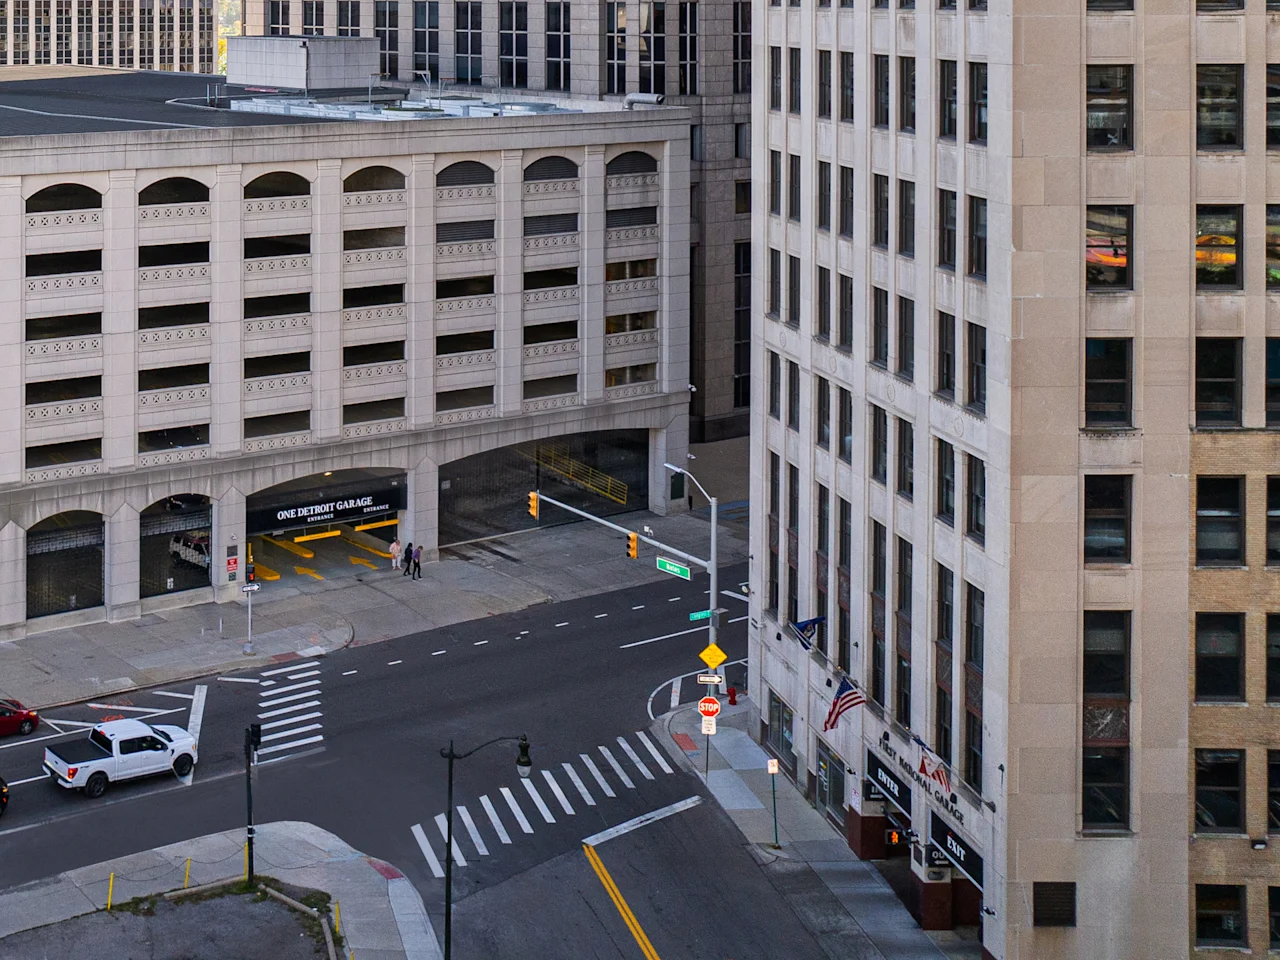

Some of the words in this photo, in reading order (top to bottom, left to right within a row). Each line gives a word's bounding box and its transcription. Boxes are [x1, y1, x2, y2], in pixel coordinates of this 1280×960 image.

[277, 509, 296, 520] ONE
[297, 503, 335, 516] DETROIT
[336, 497, 373, 510] GARAGE
[363, 504, 389, 513] ENTRANCE
[307, 514, 334, 522] ENTRANCE
[700, 702, 719, 712] STOP
[877, 768, 899, 797] ENTER
[879, 737, 897, 760] FIRST
[899, 756, 932, 795] NATIONAL
[934, 791, 964, 825] GARAGE
[932, 850, 946, 859] OU
[946, 835, 966, 861] EXIT
